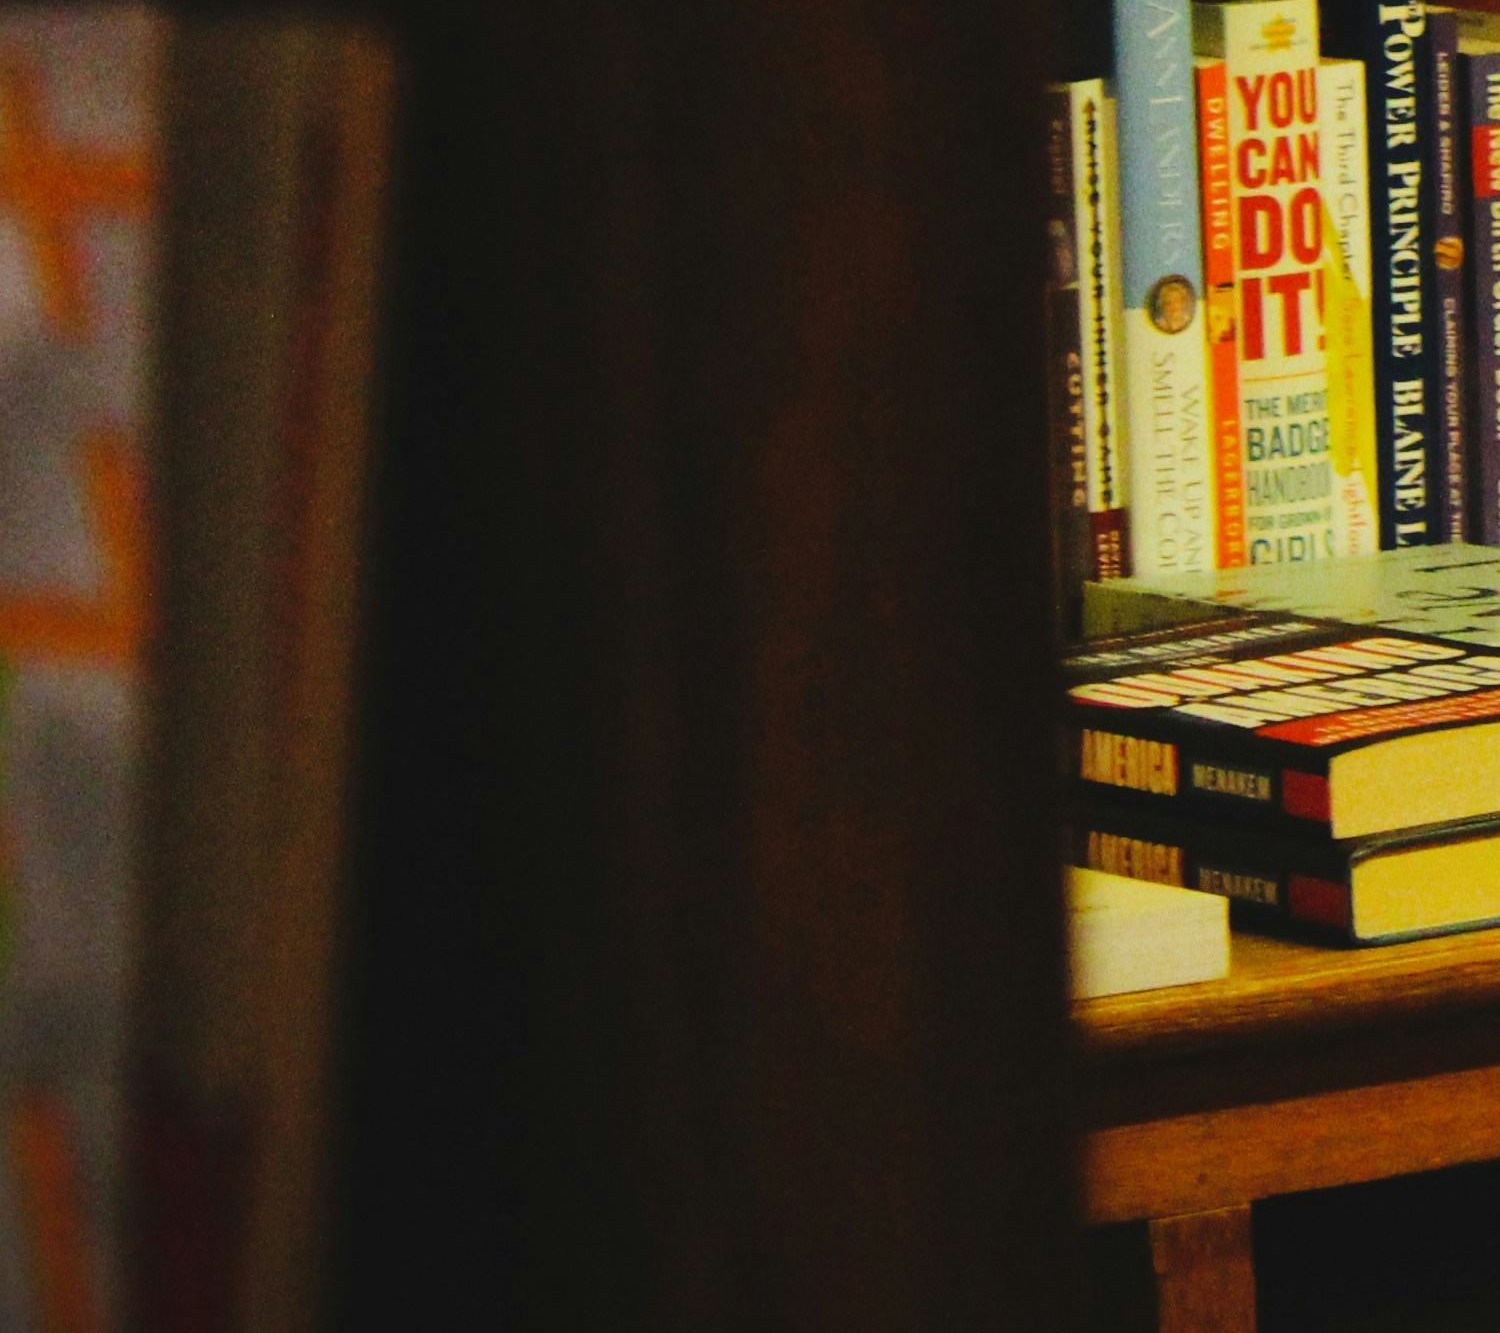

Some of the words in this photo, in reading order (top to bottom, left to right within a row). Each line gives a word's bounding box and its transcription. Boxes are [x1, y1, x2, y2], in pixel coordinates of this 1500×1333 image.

[1233, 70, 1318, 129] YOU
[1378, 2, 1424, 150] POWER
[1236, 130, 1321, 190] CAN
[1238, 188, 1324, 270] DO
[1386, 160, 1422, 360] PRINCIPLE
[1392, 379, 1425, 510] BLAINE
